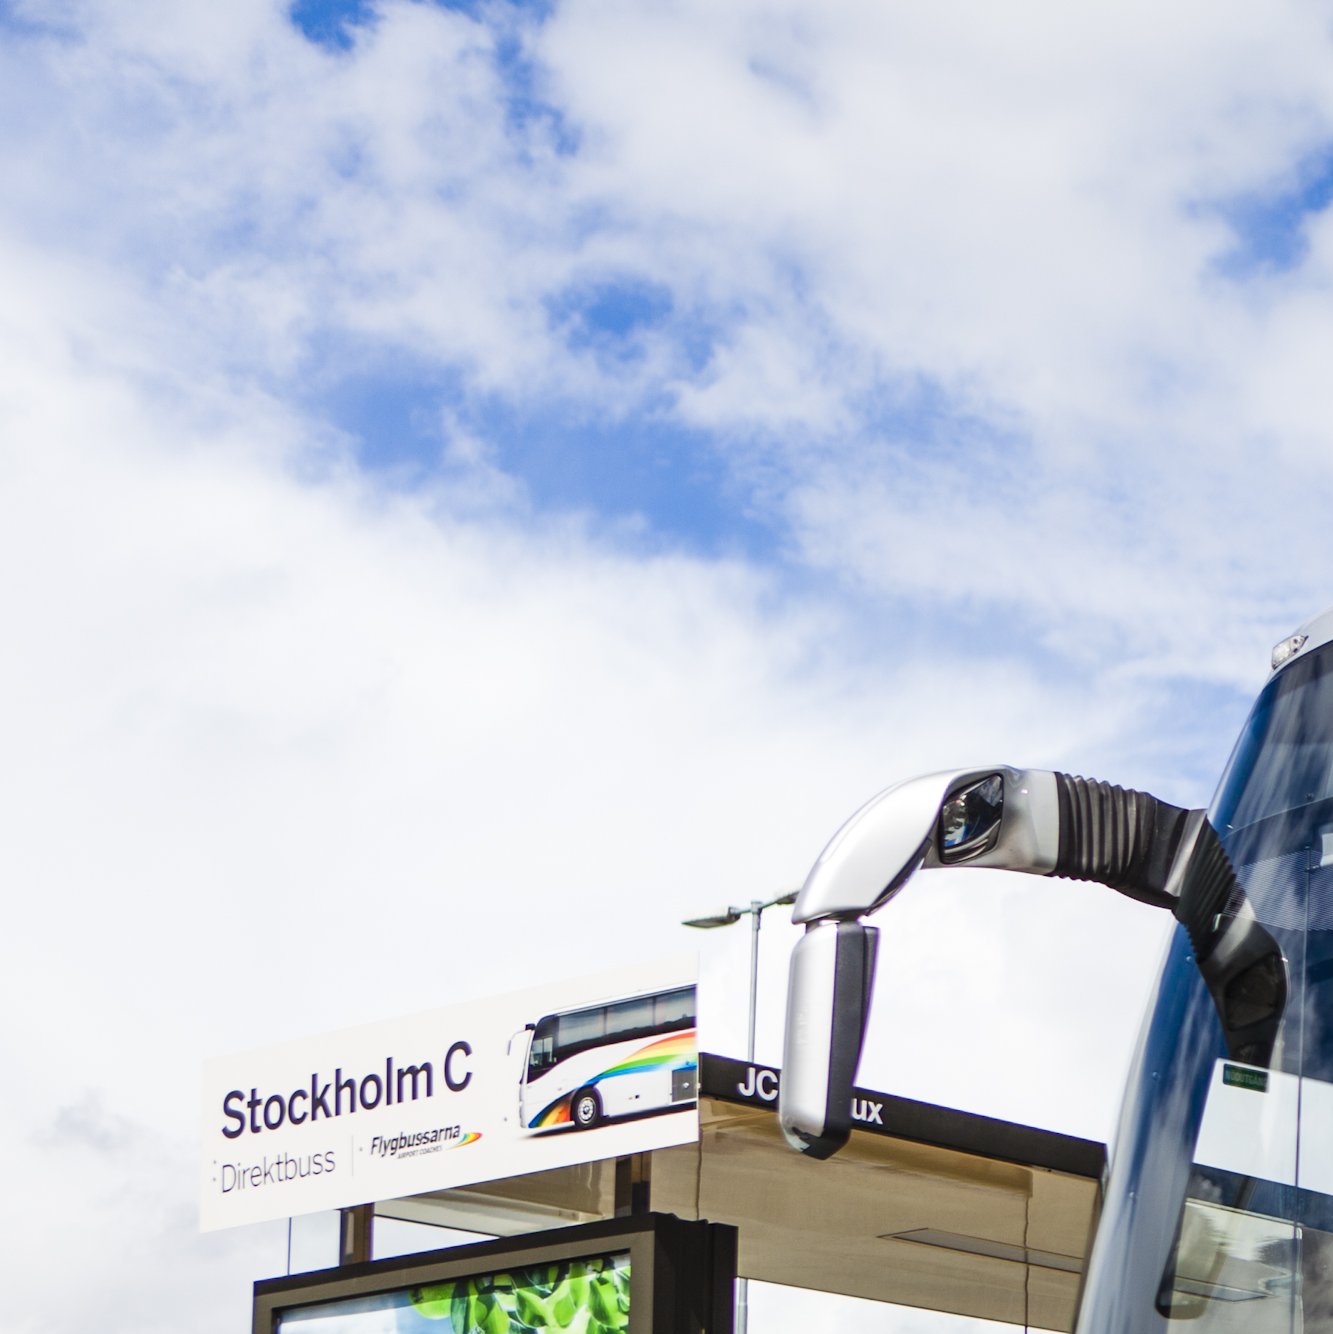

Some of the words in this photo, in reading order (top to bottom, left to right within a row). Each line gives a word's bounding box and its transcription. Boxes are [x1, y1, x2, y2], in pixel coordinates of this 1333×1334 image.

[222, 1056, 434, 1139] Stockholm
[444, 1040, 473, 1092] C
[369, 1124, 461, 1158] Flygbussarna
[221, 1150, 336, 1193] Direktbuss
